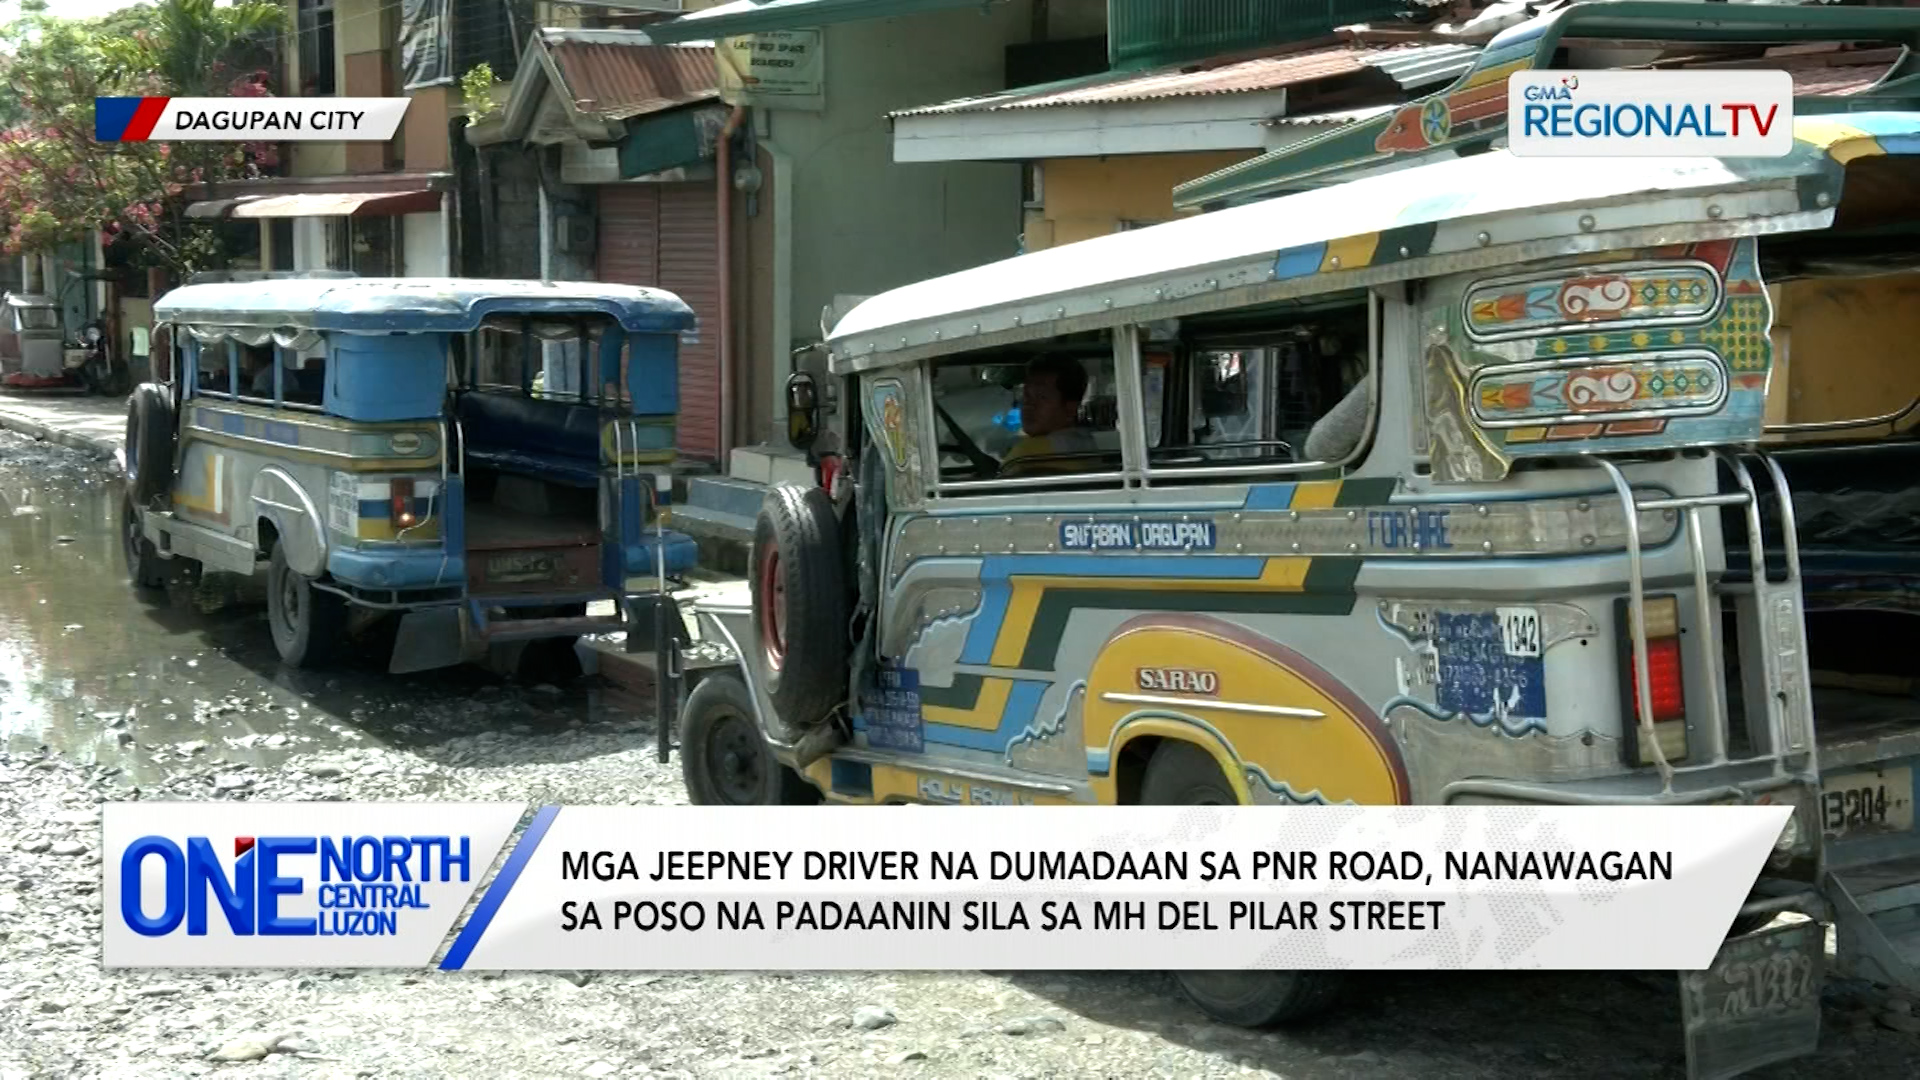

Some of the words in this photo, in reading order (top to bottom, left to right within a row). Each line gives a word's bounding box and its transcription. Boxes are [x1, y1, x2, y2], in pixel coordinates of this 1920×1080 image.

[1141, 522, 1211, 547] DAGUPAN
[1367, 510, 1409, 548] FOR
[1505, 614, 1538, 653] 1342
[1139, 668, 1217, 693] SARAO
